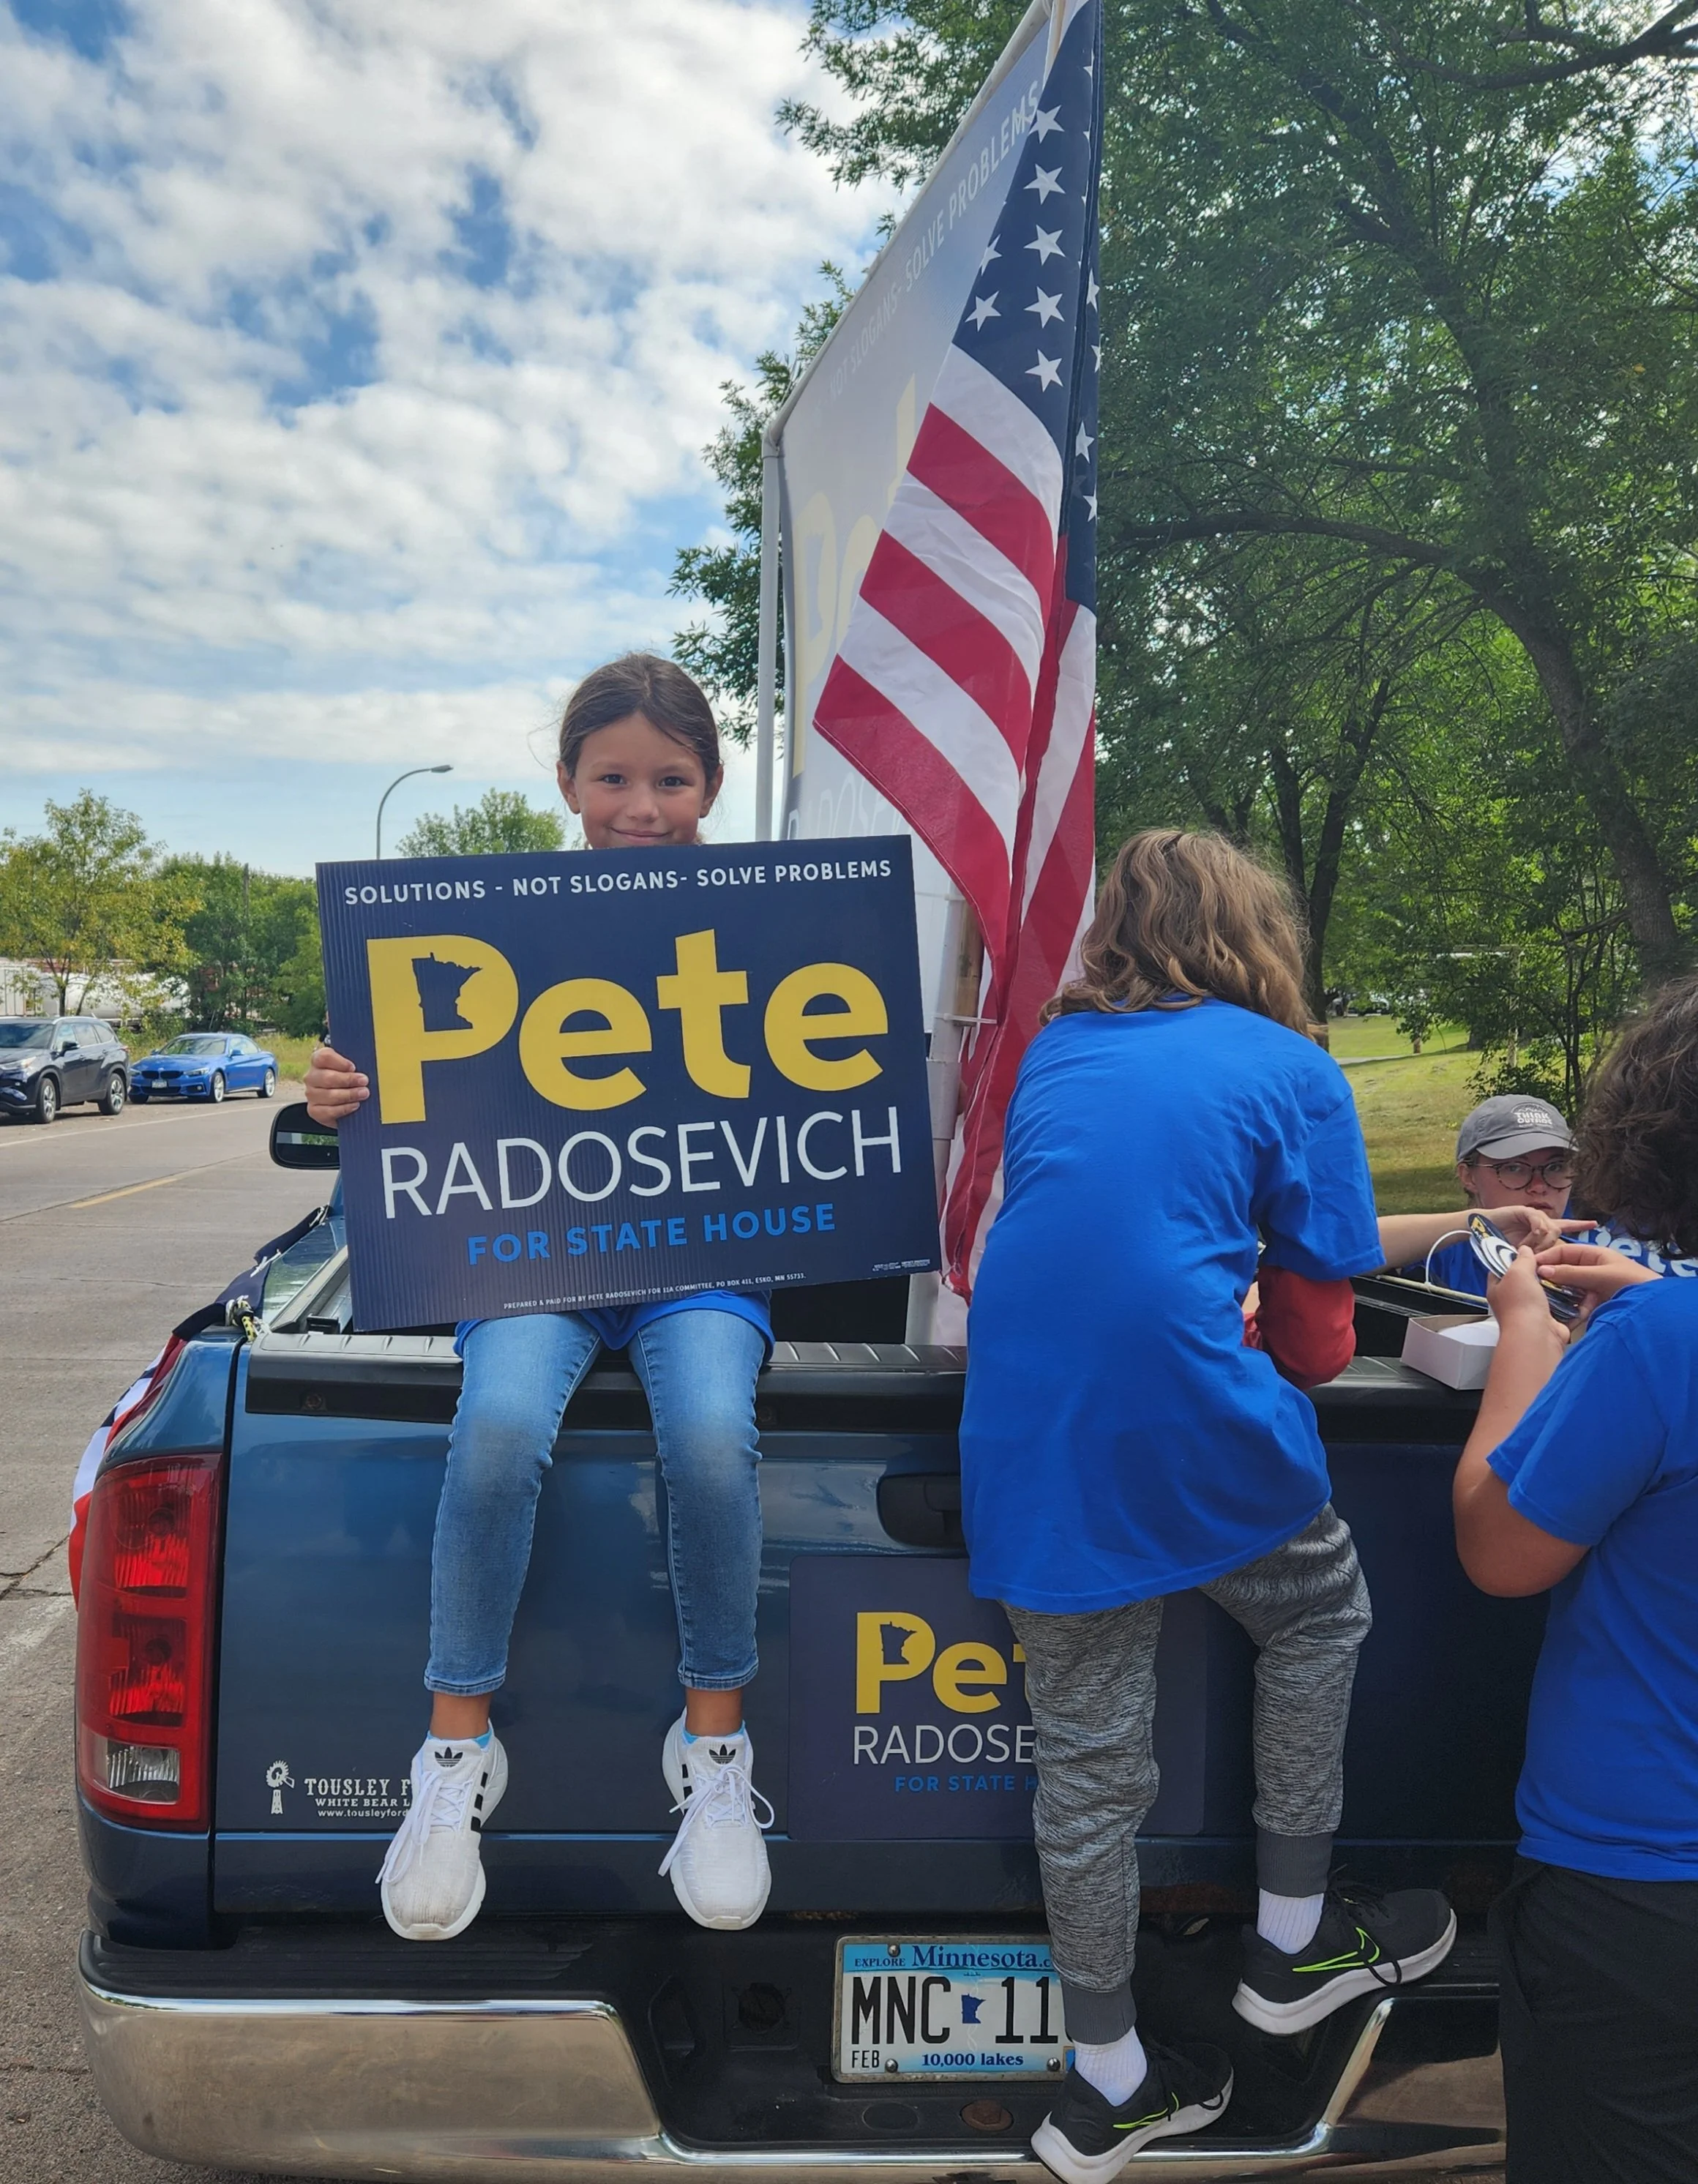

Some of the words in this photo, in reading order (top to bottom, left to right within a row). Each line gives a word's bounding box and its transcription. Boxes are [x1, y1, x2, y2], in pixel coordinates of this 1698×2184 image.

[905, 209, 945, 292] SOLVE
[949, 80, 1039, 230] PROBLEMS
[345, 880, 486, 905] SOLUTIONS
[512, 877, 561, 897] NOT
[697, 865, 766, 887] SOLVE
[775, 859, 891, 883] PROBLEMS
[366, 928, 889, 1125] Pete
[381, 1106, 902, 1219] RADOSEVICH
[468, 1230, 551, 1265] FOR
[567, 1217, 688, 1257] STATE
[703, 1203, 837, 1243] HOUSE
[504, 1299, 537, 1309] PREPARED
[546, 1298, 561, 1306] PAID
[605, 1288, 646, 1298] RADOSEVICH
[648, 1286, 662, 1295] FOR
[662, 1284, 674, 1293] 11A
[675, 1282, 715, 1292] COMMITTEE,
[716, 1280, 725, 1288] PO
[727, 1279, 741, 1287] BOX
[755, 1276, 774, 1284] ESKO,
[774, 1274, 785, 1282] MN
[856, 1612, 1027, 1714] Pe
[853, 1724, 1036, 1765] RADOSE
[304, 1778, 390, 1796] TOUSLEY
[315, 1798, 359, 1807] WHITE
[363, 1798, 398, 1807] BEAR
[894, 1776, 939, 1792] FOR
[948, 1775, 1016, 1791] STATE
[318, 1809, 409, 1819] www.tousleyford
[854, 1958, 905, 1967] EXPLORE
[912, 1945, 1051, 1968] Minnesota.c
[851, 1976, 951, 2045] MNC
[995, 1976, 1073, 2044] 11
[851, 2050, 880, 2069] FEB
[921, 2053, 976, 2068] 10,000
[981, 2052, 1024, 2066] lakes
